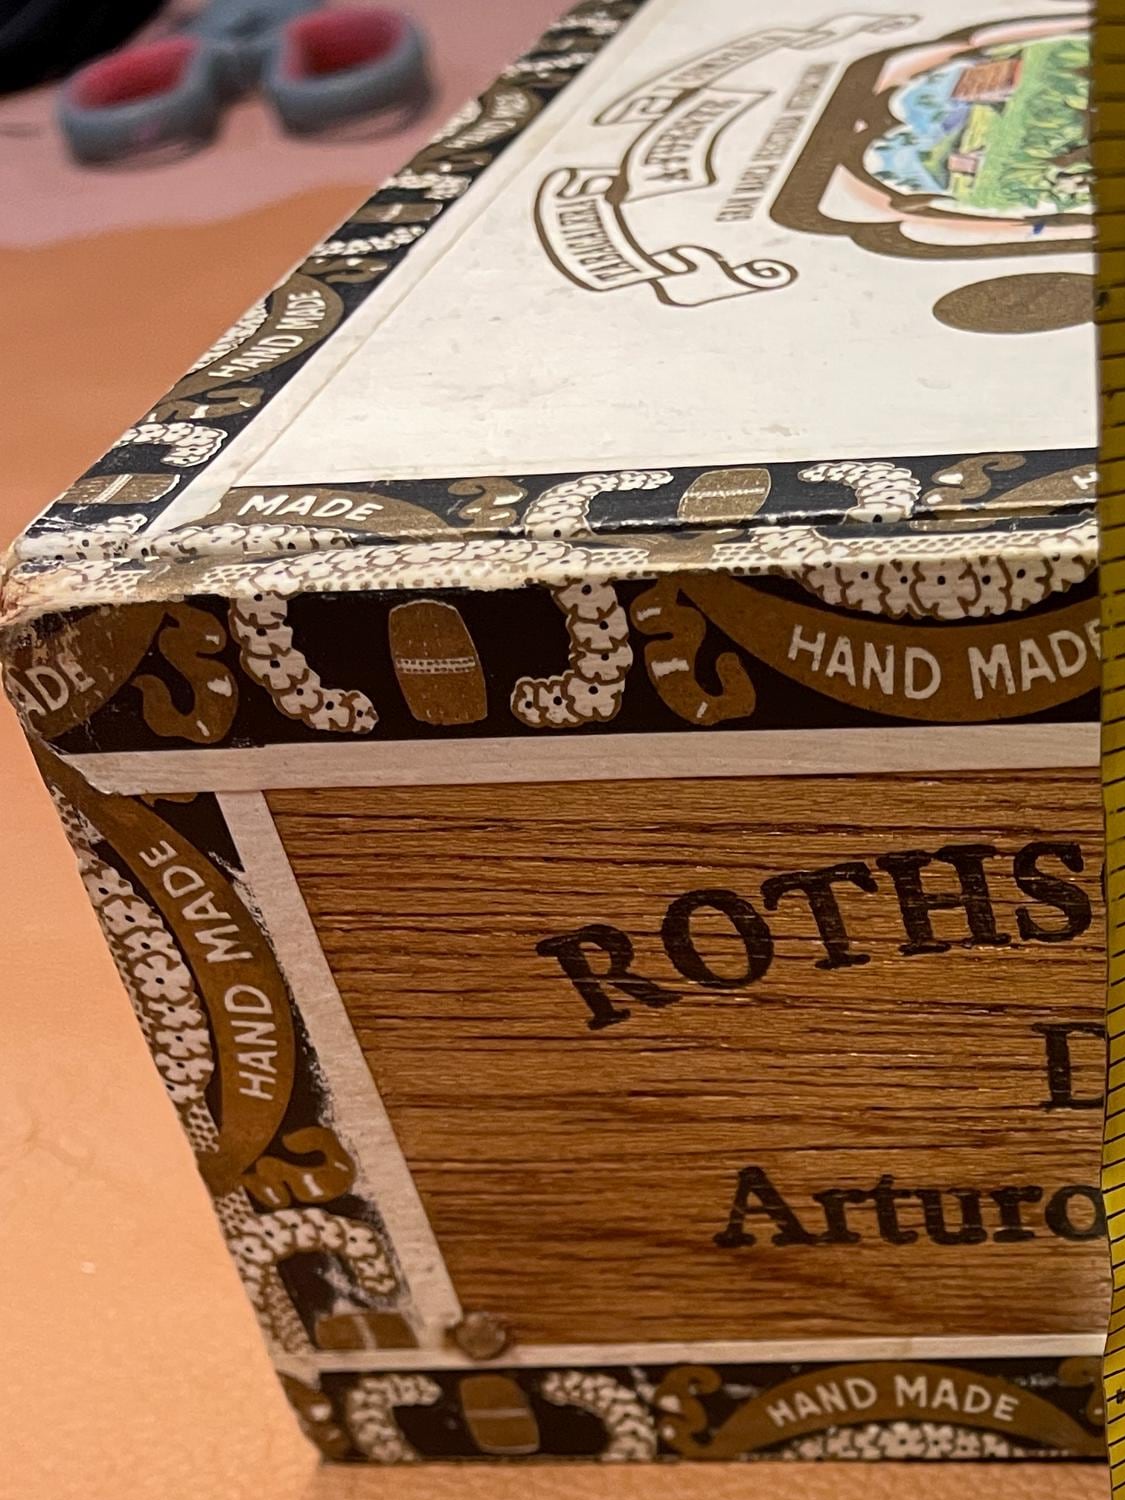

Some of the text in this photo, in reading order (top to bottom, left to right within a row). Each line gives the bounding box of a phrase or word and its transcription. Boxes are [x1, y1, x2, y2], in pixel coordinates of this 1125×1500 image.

[209, 289, 322, 379] HAND MADE
[238, 494, 383, 523] MADE
[7, 653, 96, 716] ADE
[787, 624, 942, 700] HAND
[138, 840, 278, 1101] HAND MADE
[713, 1166, 1104, 1248] Arturo
[767, 1372, 1020, 1427] HAND MADE
